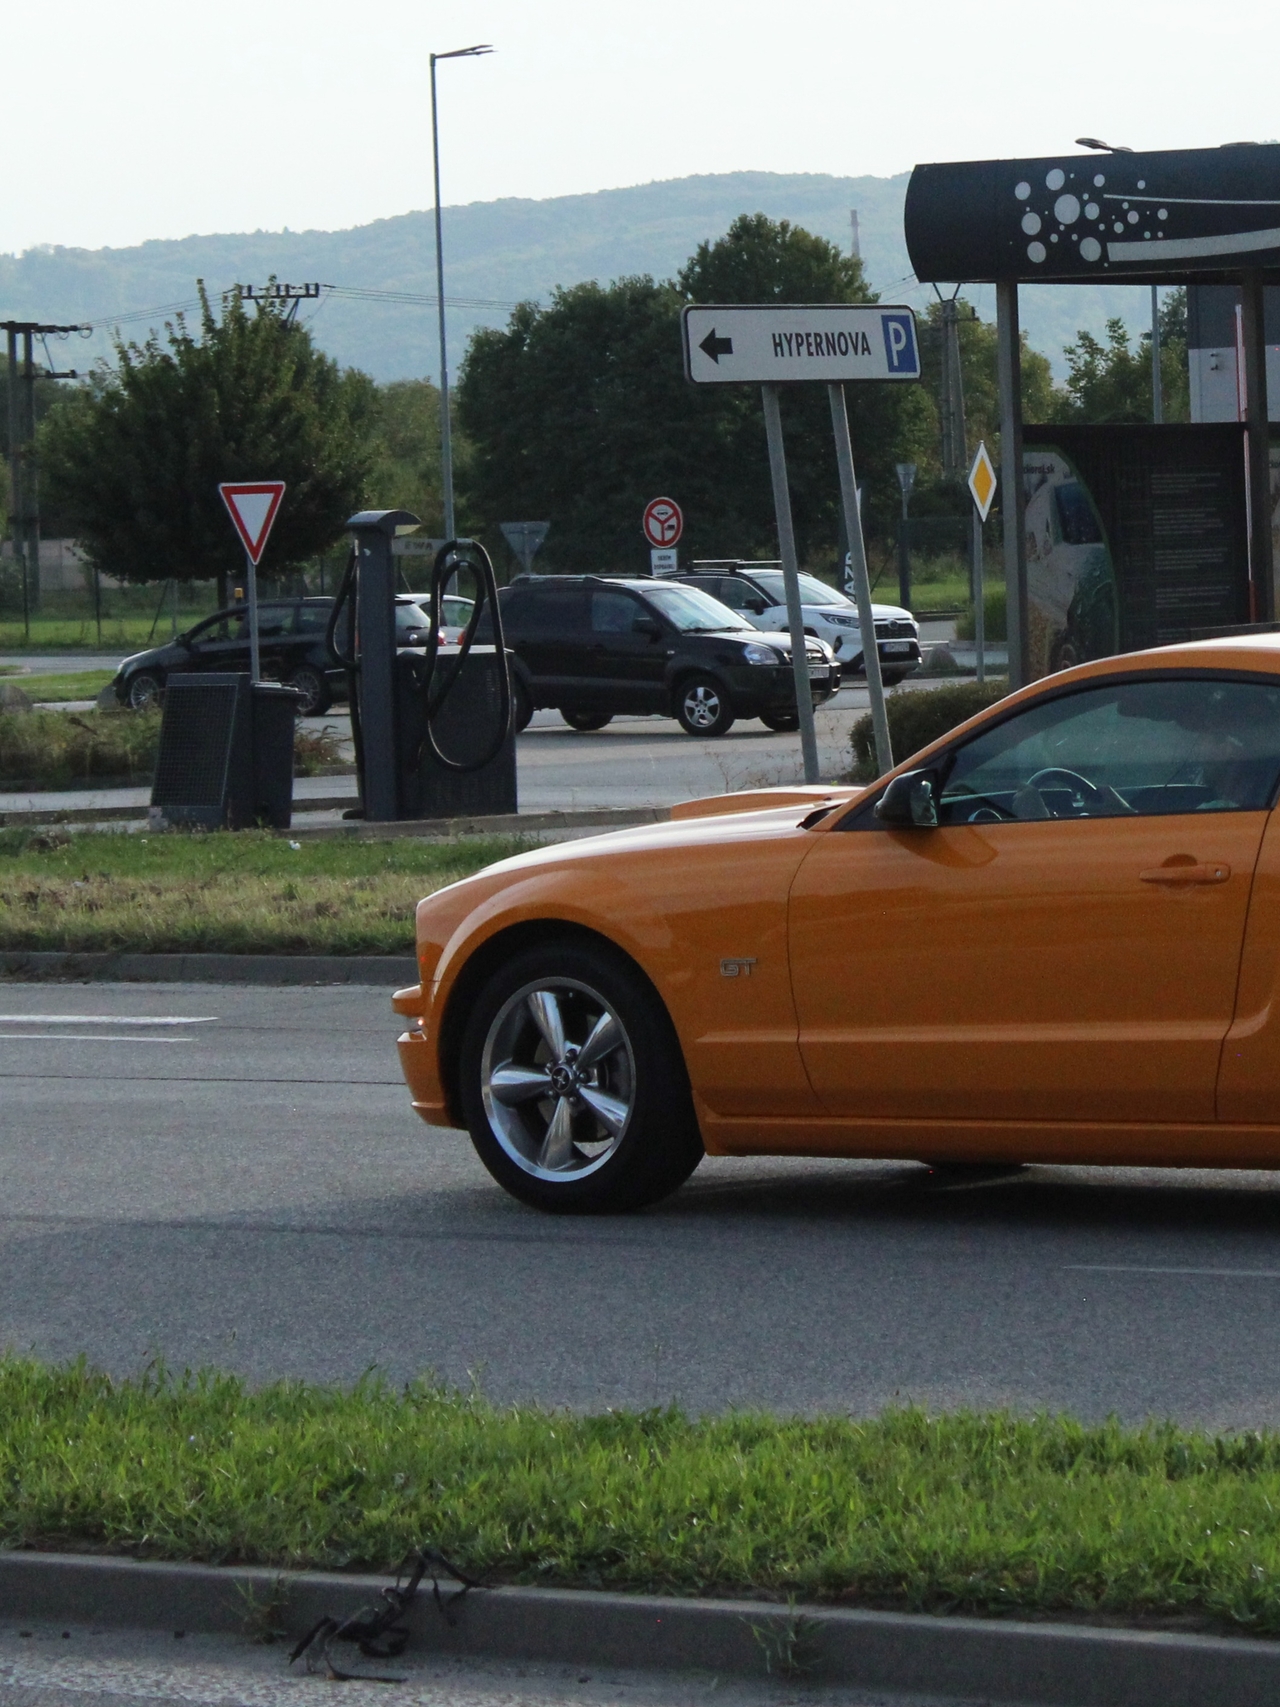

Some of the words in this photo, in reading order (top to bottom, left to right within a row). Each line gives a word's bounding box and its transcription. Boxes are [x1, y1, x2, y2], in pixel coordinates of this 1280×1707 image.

[772, 331, 871, 357] HYPERNOVA
[888, 321, 906, 366] P
[721, 957, 757, 977] GT
